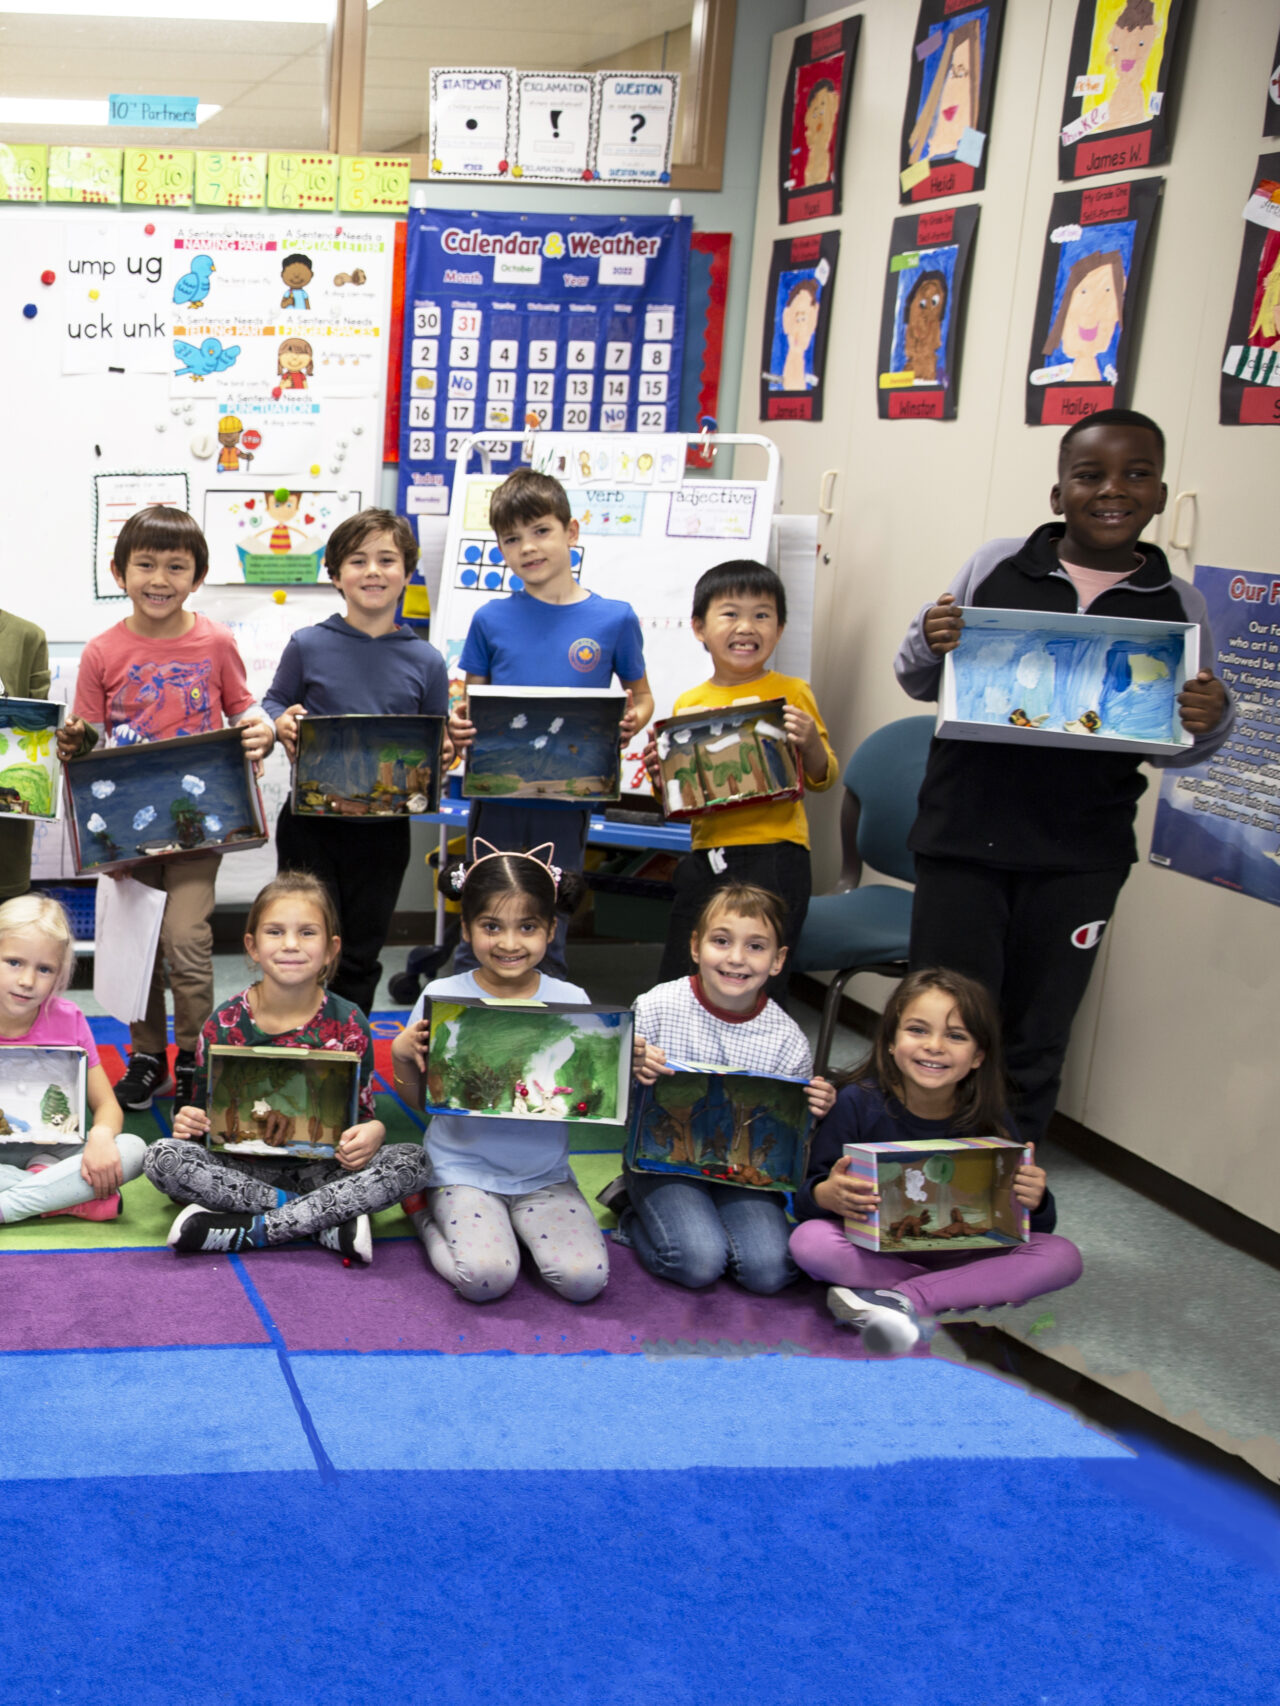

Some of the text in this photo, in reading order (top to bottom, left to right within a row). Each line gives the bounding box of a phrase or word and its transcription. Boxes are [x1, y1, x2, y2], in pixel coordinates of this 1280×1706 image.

[443, 79, 502, 91] STATEMENT
[524, 82, 588, 93] EXCLAMATION
[615, 83, 663, 95] QUESTION
[142, 102, 196, 121] Partners
[137, 154, 148, 172] 2
[208, 155, 223, 172] 3
[1086, 144, 1142, 171] James W.
[281, 159, 293, 178] 4
[351, 160, 365, 181] 5
[136, 179, 148, 201] 8
[930, 173, 956, 193] Heidi
[209, 183, 220, 200] 7
[282, 184, 291, 203] 6
[349, 189, 364, 208] 5
[443, 230, 660, 256] Calendar & Weather
[69, 259, 115, 279] ump
[127, 256, 163, 283] ug
[501, 263, 534, 273] October
[443, 271, 483, 284] Month
[564, 274, 589, 287] Year
[68, 314, 112, 338] uck
[123, 313, 165, 338] unk
[344, 317, 372, 325] Needs
[417, 313, 438, 328] 30
[458, 316, 476, 331] 31
[656, 318, 663, 333] 1
[421, 347, 430, 360] 2
[652, 350, 662, 364] 8
[646, 380, 661, 395] 15
[899, 401, 936, 416] Winston
[567, 409, 587, 424] 20
[641, 412, 661, 425] 22
[413, 438, 430, 452] 23
[586, 490, 625, 502] verb
[676, 488, 752, 505] adjective
[1230, 577, 1266, 601] Our
[1249, 621, 1269, 634] Our
[1229, 637, 1278, 653] who art in
[1218, 651, 1275, 670] hallowed be
[1222, 669, 1238, 683] Thy
[1262, 693, 1274, 706] be
[1240, 723, 1256, 739] day
